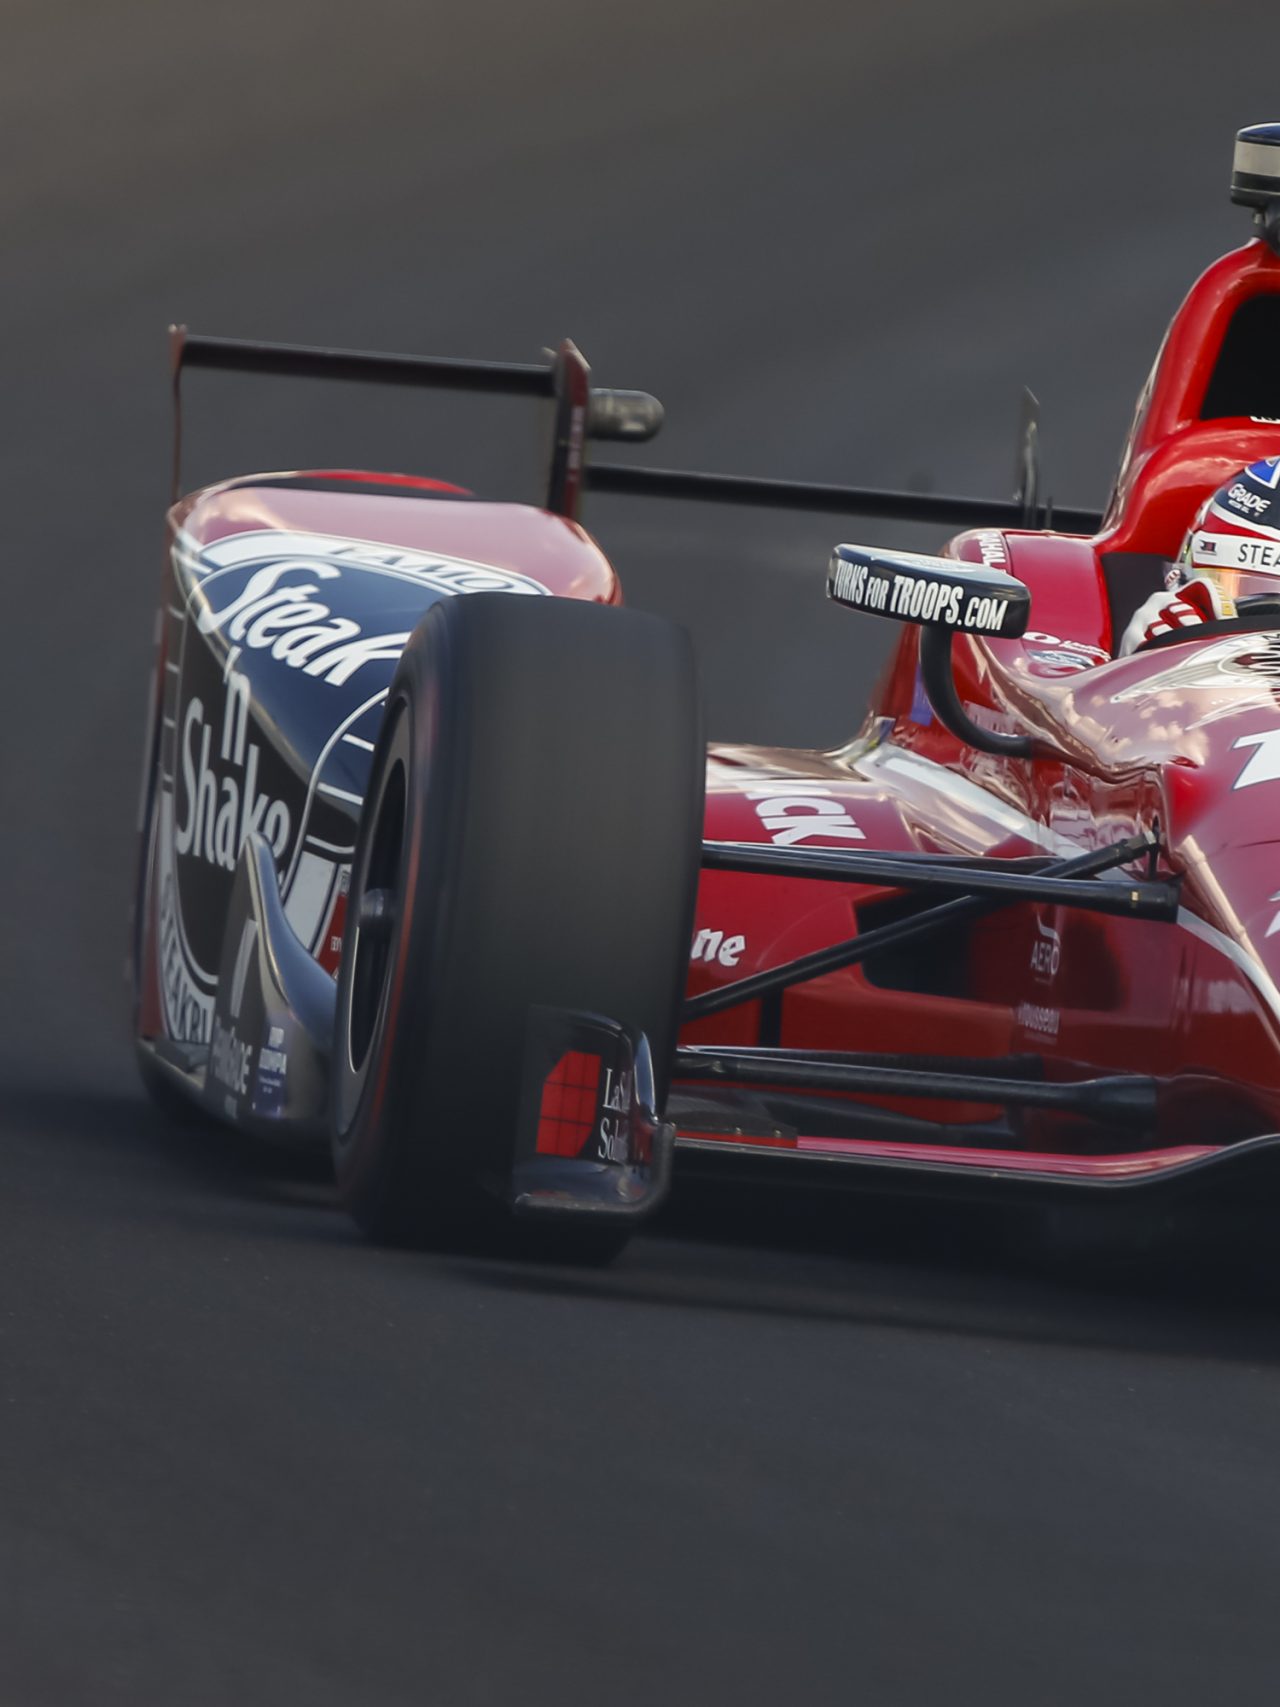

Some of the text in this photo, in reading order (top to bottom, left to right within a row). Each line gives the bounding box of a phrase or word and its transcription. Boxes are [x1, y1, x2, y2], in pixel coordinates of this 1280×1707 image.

[197, 560, 413, 687] Steak
[834, 559, 1009, 631] TURNS FOR TROOPS.COM
